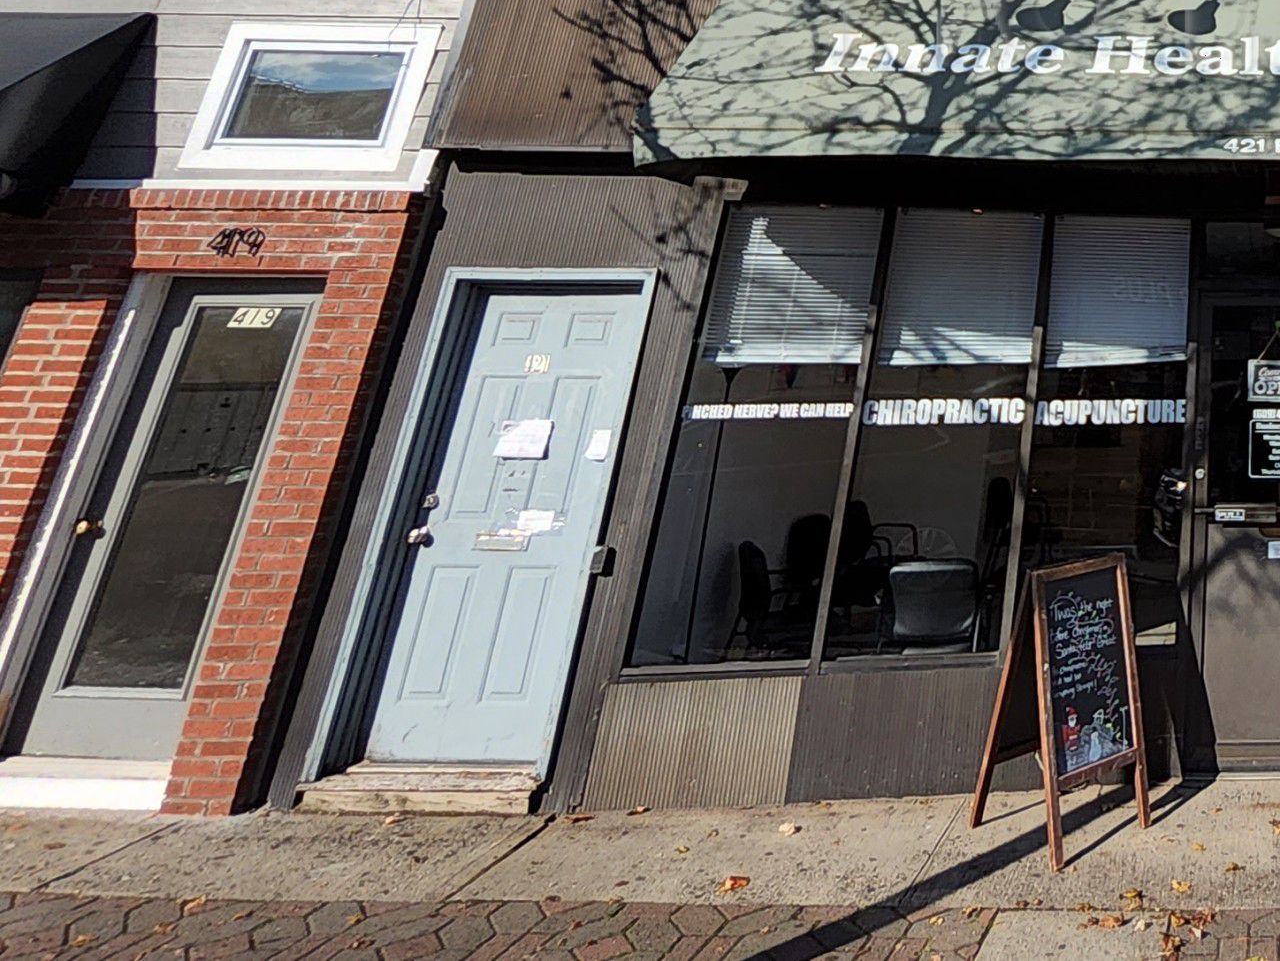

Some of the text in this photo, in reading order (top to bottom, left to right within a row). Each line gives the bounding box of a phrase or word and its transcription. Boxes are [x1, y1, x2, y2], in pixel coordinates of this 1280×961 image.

[814, 32, 1063, 75] Innate
[1223, 138, 1266, 153] 421
[206, 227, 266, 258] 419
[233, 309, 275, 326] 419
[733, 404, 779, 419] NERVE?
[779, 404, 800, 417] WE
[800, 404, 824, 417] CAN
[825, 403, 854, 417] HELP
[862, 398, 1025, 425] CHIROPRACTIC
[1034, 398, 1187, 426] ACUPUNCTURE
